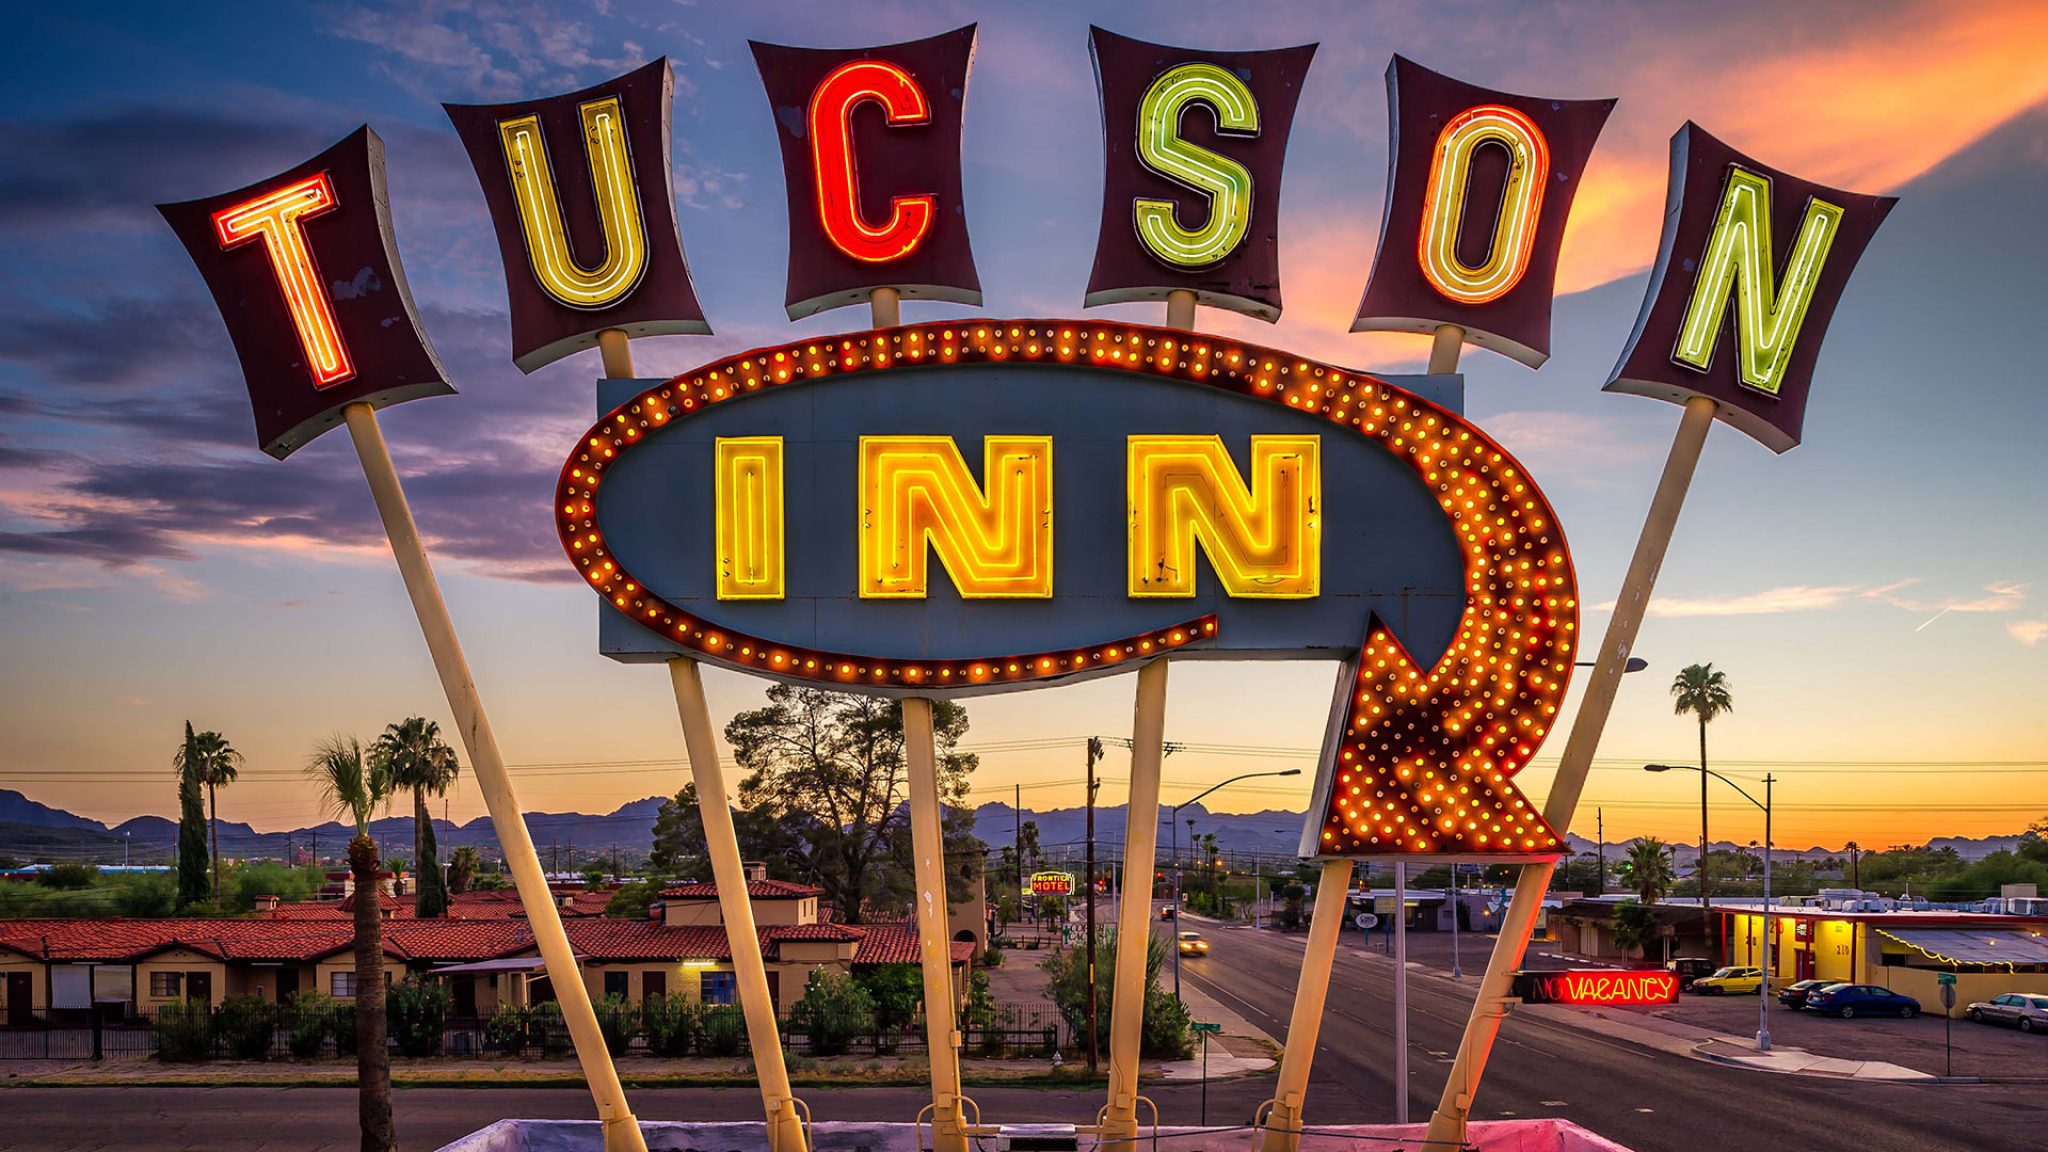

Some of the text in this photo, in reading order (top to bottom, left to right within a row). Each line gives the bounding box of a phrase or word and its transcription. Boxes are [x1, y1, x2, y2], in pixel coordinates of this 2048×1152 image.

[211, 59, 1846, 399] TUCSON
[716, 434, 1322, 600] INN
[1033, 882, 1070, 891] MOTEL
[1566, 977, 1673, 1000] VACANCY
